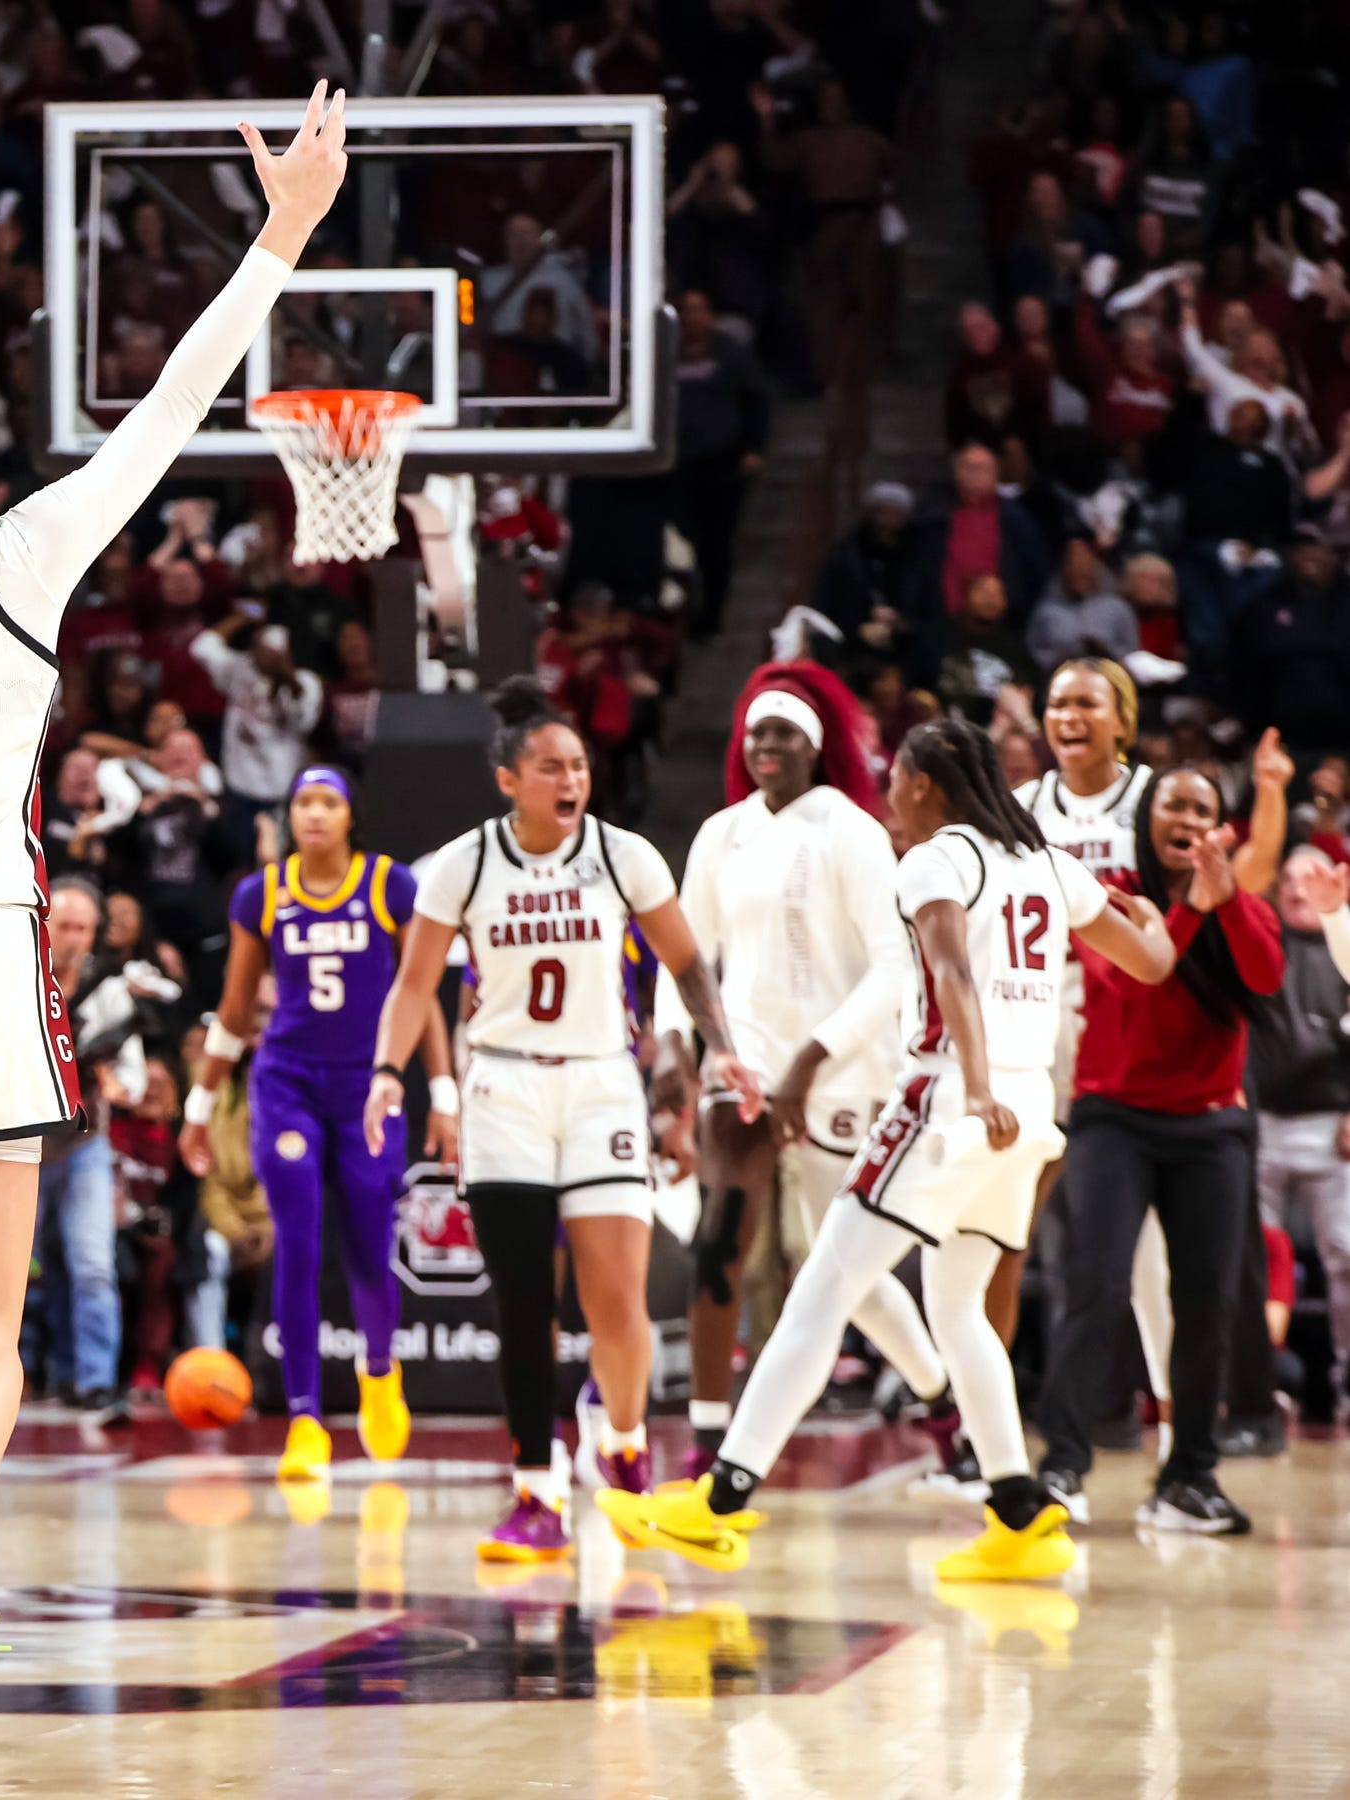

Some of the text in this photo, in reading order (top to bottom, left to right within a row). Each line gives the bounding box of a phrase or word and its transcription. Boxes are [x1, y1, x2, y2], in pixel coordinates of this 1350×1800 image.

[507, 888, 582, 915] SOUTH
[283, 920, 370, 955] LSU
[489, 918, 602, 948] CAROLINA
[1001, 893, 1049, 971] 12
[308, 955, 346, 1012] 5
[528, 957, 566, 1022] 0
[433, 1322, 500, 1360] Life
